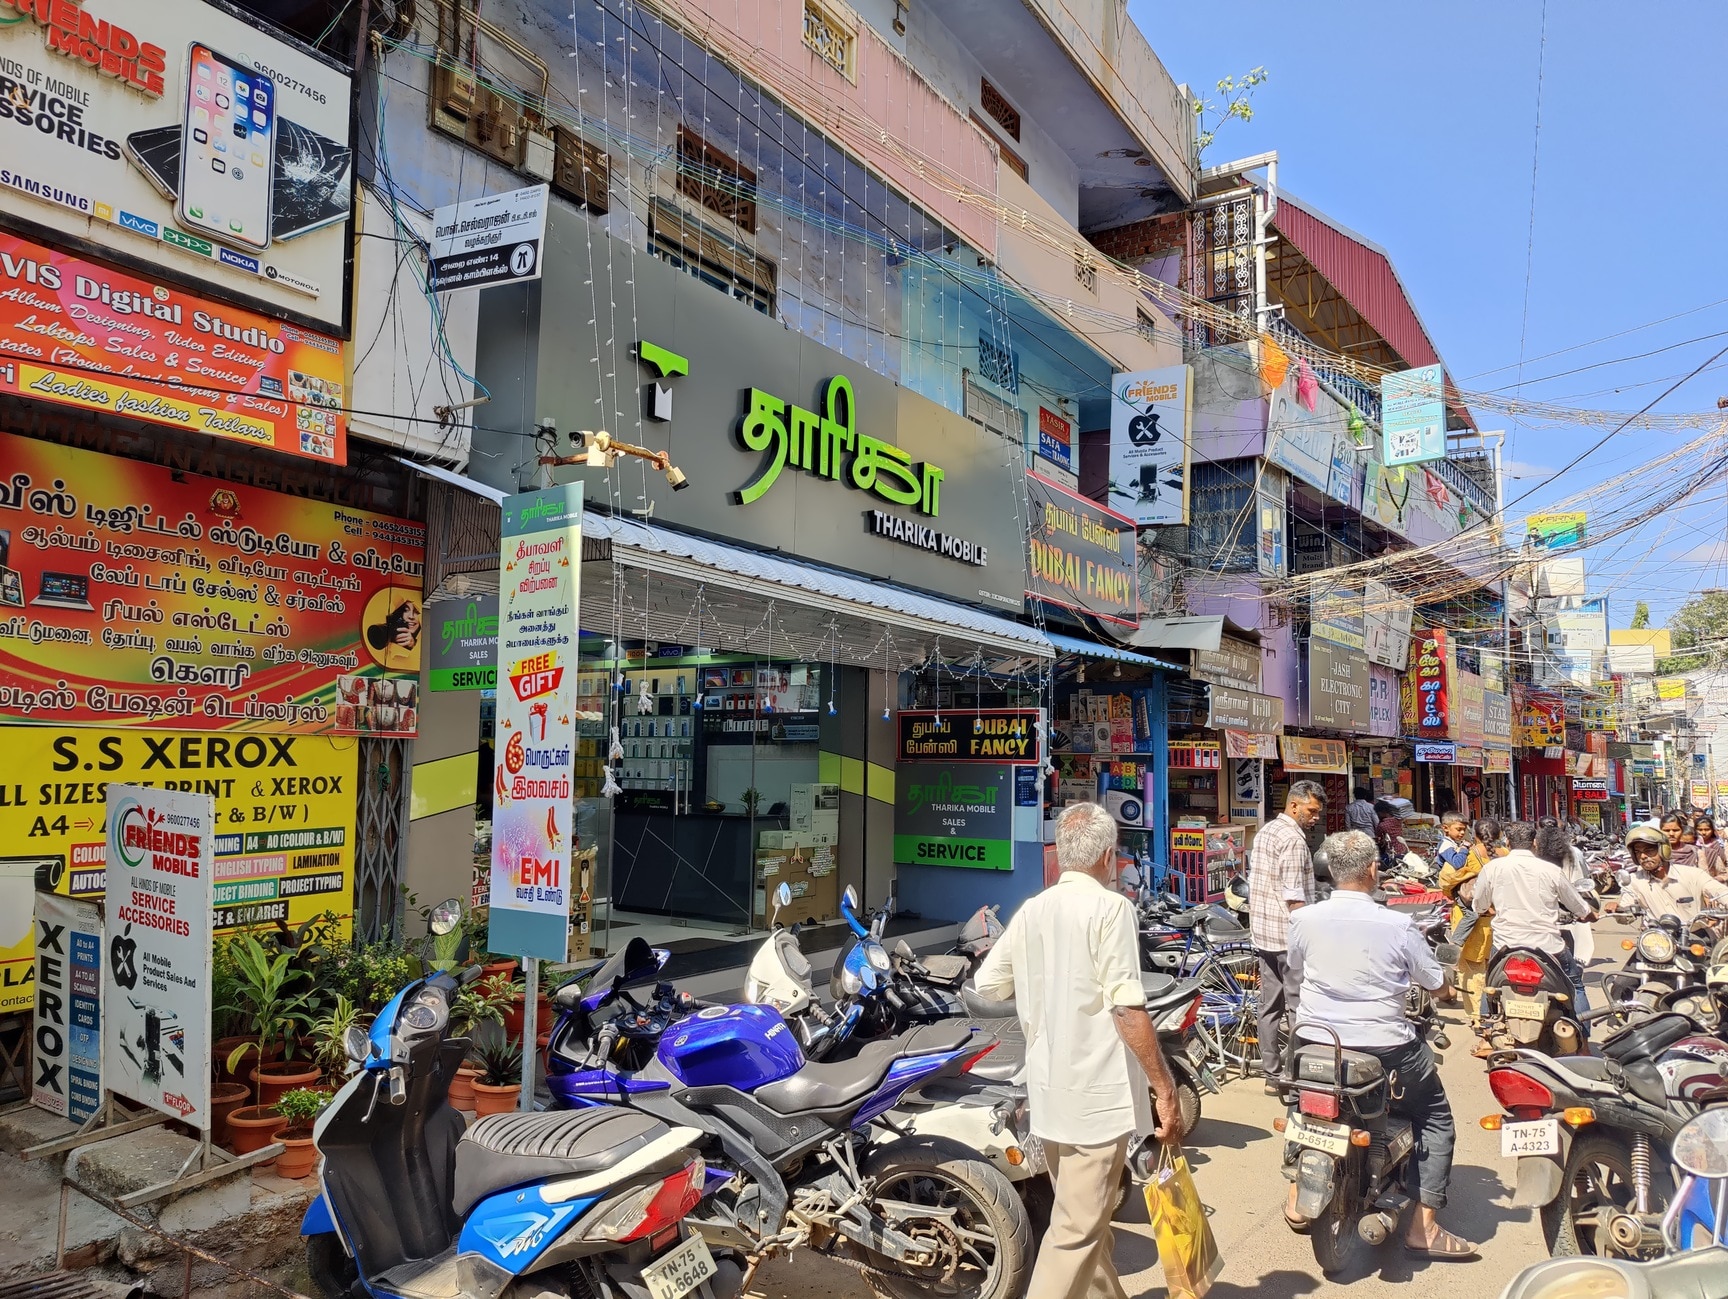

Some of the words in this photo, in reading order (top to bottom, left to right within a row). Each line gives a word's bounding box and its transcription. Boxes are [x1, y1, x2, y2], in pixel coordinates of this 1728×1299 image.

[48, 26, 165, 98] MOBILE
[26, 68, 43, 86] OF
[45, 76, 90, 107] MOBILE
[0, 169, 88, 211] SAMSUNG
[221, 252, 257, 269] NOKIA
[490, 253, 499, 262] 14
[278, 274, 320, 293] MOTOROLA
[75, 275, 183, 325] Digital
[193, 310, 286, 354] Studio
[0, 287, 63, 314] Album
[69, 303, 156, 341] Designing,
[164, 330, 206, 353] Video
[212, 344, 267, 372] Editing
[14, 315, 97, 348] Labtops
[104, 336, 158, 363] Sales
[185, 357, 248, 386] Service
[1128, 383, 1178, 398] FRIENDS
[1146, 393, 1177, 402] MOBILE
[30, 372, 110, 403] Ladies
[115, 391, 190, 425] fashion
[198, 407, 273, 442] Tailars.
[1046, 413, 1065, 432] YASIR
[733, 374, 945, 517] தாரிகா
[1041, 432, 1060, 452] SAFA
[334, 511, 363, 526] Phone
[520, 497, 565, 529] தாரிகா
[86, 503, 203, 542] டிஜிட்டல்
[209, 520, 320, 560] ஸ்டுடியோ
[344, 525, 363, 535] Cell
[868, 509, 938, 552] THARIKA
[940, 532, 988, 567] MOBILE
[1081, 513, 1120, 554] பேன்ஸி
[21, 525, 100, 550] ஆல்பம்
[218, 556, 288, 580] வீடியோ
[293, 569, 361, 592] எடிட்டிங்
[516, 536, 564, 561] தீபாவளி
[528, 560, 550, 575] சிறப்பு
[1030, 537, 1081, 592] DUBAI
[1086, 559, 1132, 608] FANCY
[90, 562, 139, 586] லேப்
[145, 572, 187, 593] டாப்
[192, 576, 258, 602] சேல்ஸ்
[285, 590, 345, 613] சர்வீஸ்
[519, 575, 558, 594] விற்பனை
[103, 599, 164, 623] ரியல்
[172, 606, 290, 637] எஸ்டேட்ஸ்
[507, 605, 534, 622] நீங்கள்
[536, 603, 569, 620] வாங்கும்
[518, 623, 556, 633] அனைத்து
[102, 628, 156, 653] தோப்பு,
[164, 634, 203, 655] வயல்
[211, 640, 255, 659] வாங்க
[263, 645, 295, 663] விற்க
[298, 650, 358, 670] அணுகவும்
[460, 638, 488, 648] THARIKA
[469, 651, 488, 660] SALES
[521, 653, 550, 674] FREE
[1333, 661, 1351, 678] JASH
[519, 671, 556, 697] GIFT
[1320, 677, 1363, 699] ELECTRONIC
[86, 685, 195, 720] பேஷன்
[203, 693, 329, 725] டெய்லர்ஸ்
[1335, 699, 1351, 715] CITY
[1489, 706, 1507, 720] STAR
[912, 718, 951, 739] துபாய்
[973, 718, 1027, 736] DUBAI
[53, 735, 124, 772] S.S
[141, 736, 297, 770] XEROX
[505, 731, 524, 774] 6
[525, 744, 569, 769] பொருட்கள்
[906, 738, 957, 755] பேன்ஸி
[970, 738, 1029, 756] FANCY
[39, 783, 107, 806] SIZES
[271, 776, 343, 796] XEROX
[511, 774, 569, 800] இலவசம்
[907, 770, 998, 816] தாரிகா
[931, 803, 965, 813] THARIKA
[966, 804, 996, 814] MOBILE
[28, 815, 70, 837] A4
[253, 804, 297, 824] B/W
[942, 817, 966, 827] SALES
[126, 822, 201, 859] FRIENDS
[246, 835, 259, 850] A4
[293, 852, 340, 870] LAMINATION
[917, 842, 986, 862] SERVICE
[152, 854, 200, 878] MOBILE
[215, 860, 252, 877] ENGLISH
[253, 857, 284, 874] TYPING
[520, 857, 560, 887] EMI
[159, 881, 176, 897] MOBILE
[238, 882, 274, 899] BINDING
[281, 877, 314, 894] PROJECT
[315, 874, 342, 891] TYPING
[131, 890, 176, 915] SERVICE
[516, 888, 534, 902] வசதி
[536, 888, 562, 906] உண்டு
[118, 905, 190, 937] ACCESSORIES
[142, 952, 151, 962] All
[152, 953, 171, 968] Mobile
[142, 964, 162, 979] Product
[163, 969, 182, 984] Sales
[184, 975, 196, 989] And
[142, 977, 167, 992] Services
[35, 919, 65, 1096] XEROX
[75, 1000, 95, 1012] IDENTITY
[172, 1097, 191, 1112] FLOOR
[1297, 1131, 1335, 1151] D-6512
[1512, 1127, 1546, 1139] TN-75
[1510, 1140, 1550, 1153] A-4323
[660, 1248, 696, 1281] TN-75
[660, 1260, 709, 1299] U-6648
